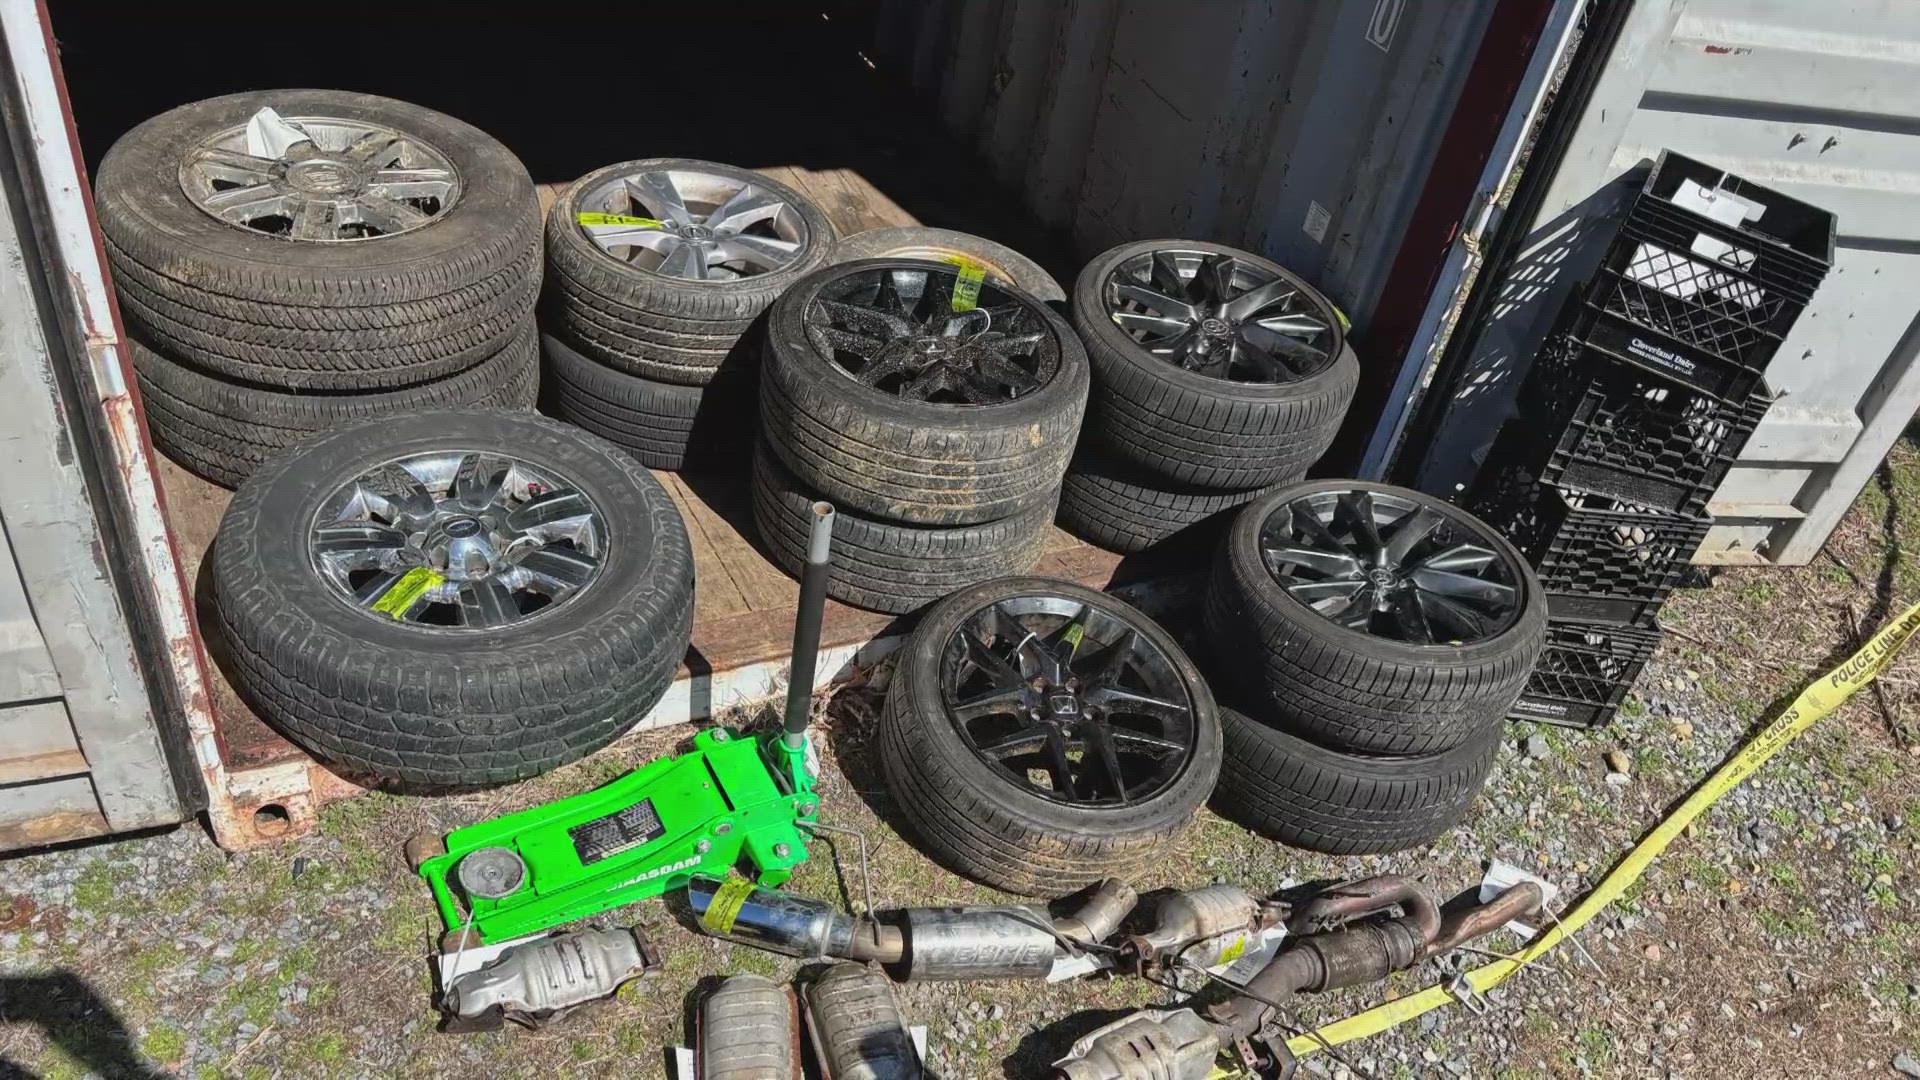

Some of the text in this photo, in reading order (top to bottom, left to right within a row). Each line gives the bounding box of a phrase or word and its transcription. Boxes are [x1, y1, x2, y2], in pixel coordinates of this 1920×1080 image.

[1631, 338, 1675, 361] Cloverland
[1673, 354, 1697, 371] Dairy
[1831, 649, 1875, 689] POLICE
[1872, 629, 1904, 656] LINE
